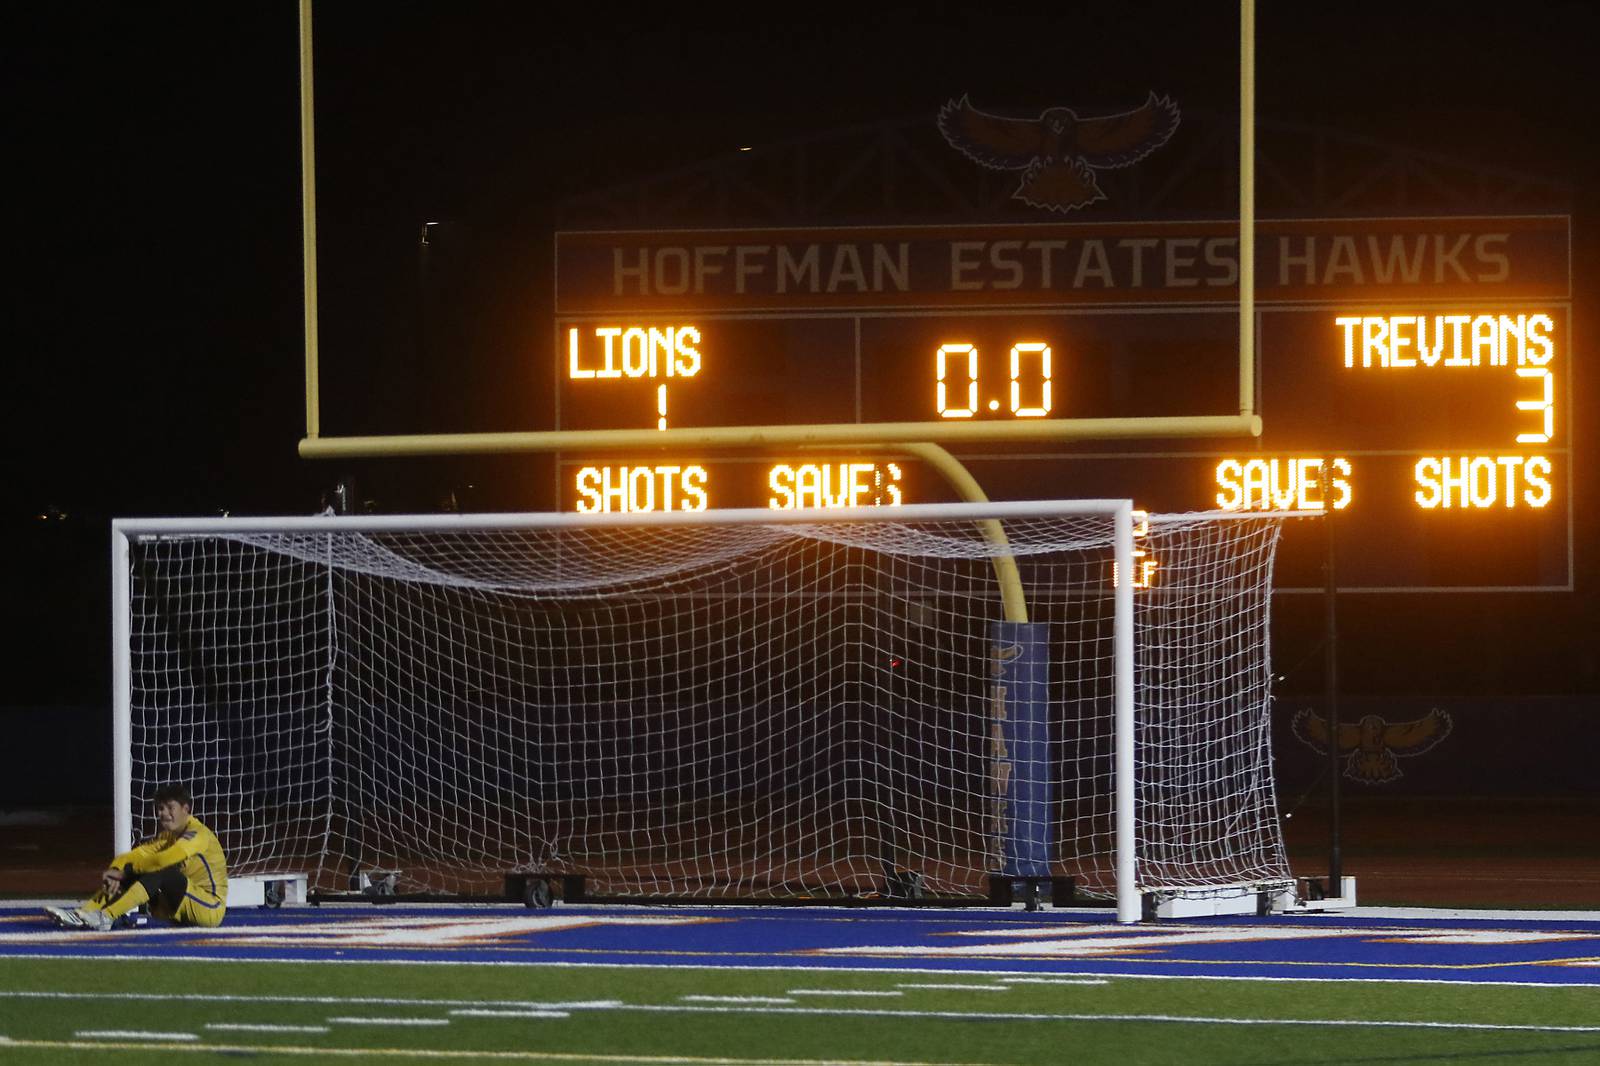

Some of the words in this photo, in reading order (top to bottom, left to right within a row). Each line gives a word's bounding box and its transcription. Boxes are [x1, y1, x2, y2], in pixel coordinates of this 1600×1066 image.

[612, 242, 910, 296] HOFFMAN
[951, 237, 1239, 290] ESTATES
[1279, 233, 1511, 285] HAWKS
[569, 326, 702, 379] LIONS
[1335, 314, 1555, 367] TREVIANS
[936, 342, 1053, 418] 0.0
[1514, 368, 1555, 444] 3
[575, 465, 709, 513] SHOTS
[768, 463, 903, 510] SAVES
[1215, 458, 1353, 510] SAVES
[1414, 456, 1553, 509] SHOTS
